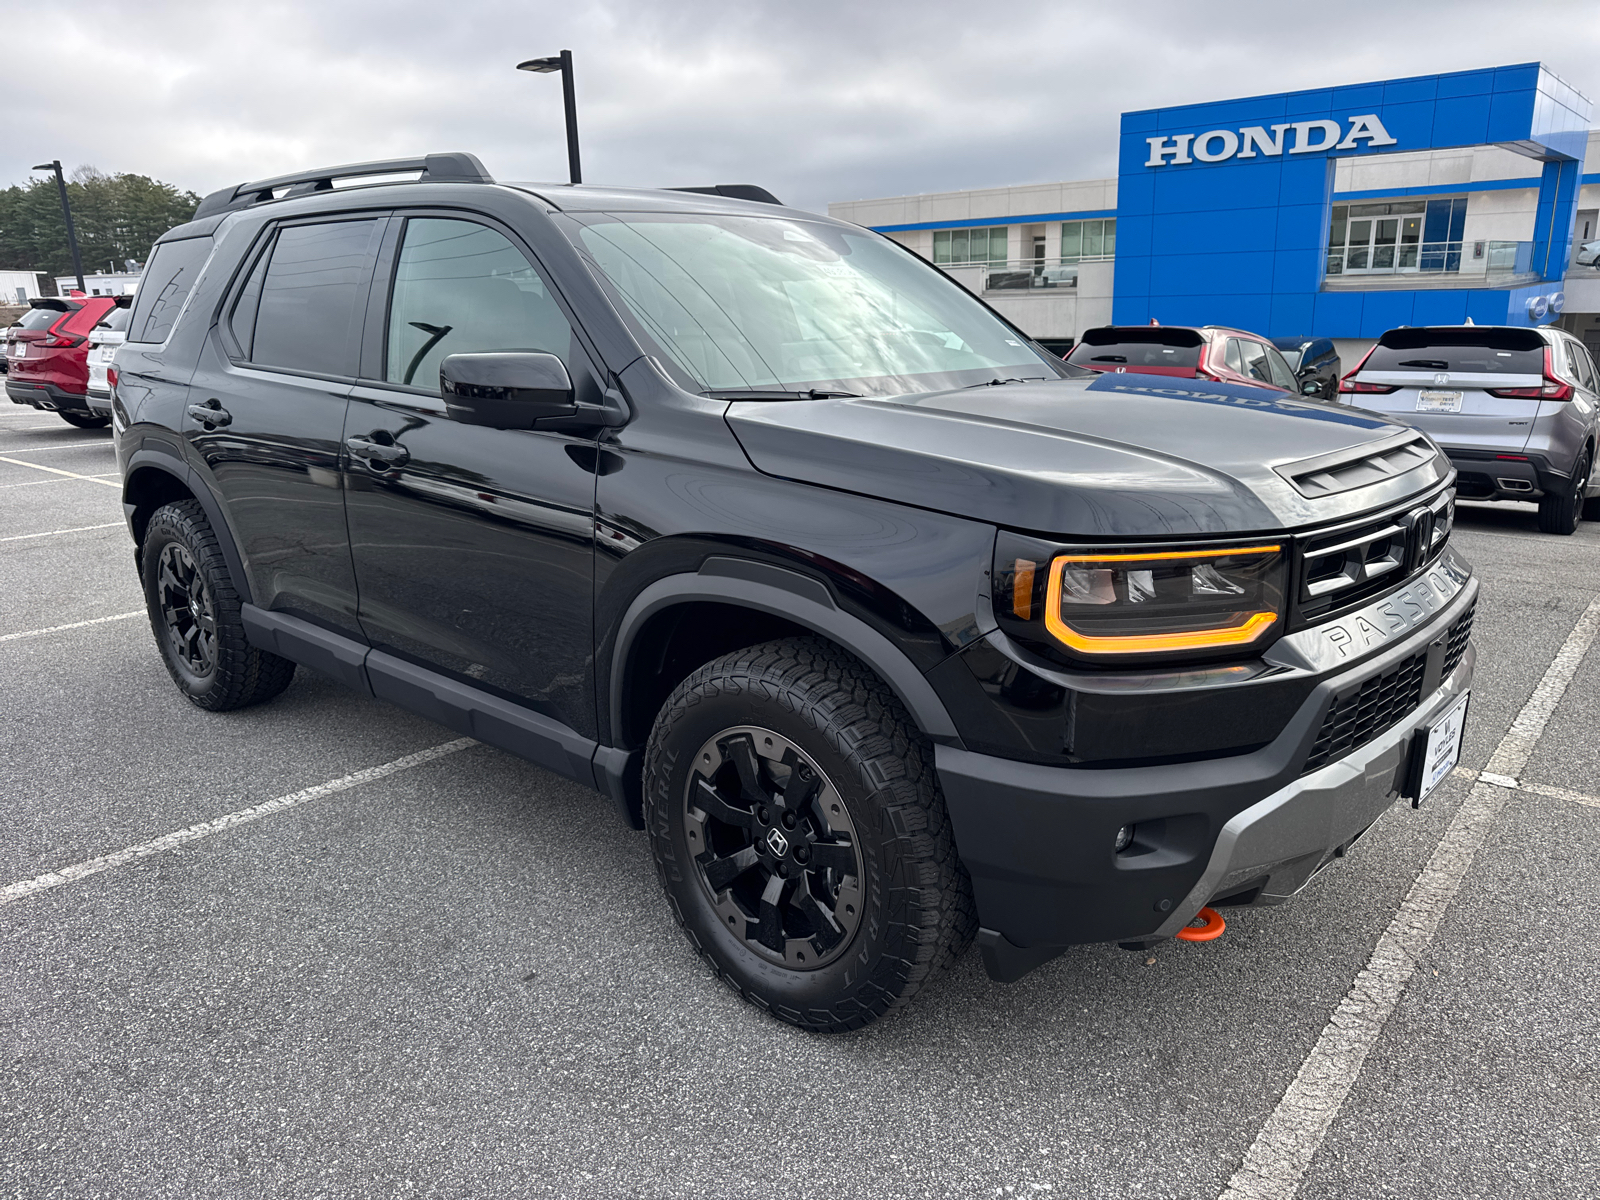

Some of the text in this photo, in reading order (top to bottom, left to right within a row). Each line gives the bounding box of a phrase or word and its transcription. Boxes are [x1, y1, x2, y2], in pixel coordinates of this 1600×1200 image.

[1145, 114, 1397, 167] HONDA
[1321, 553, 1468, 658] PASSPORT
[658, 748, 684, 883] GENERAL
[834, 773, 880, 942] GRABBER
